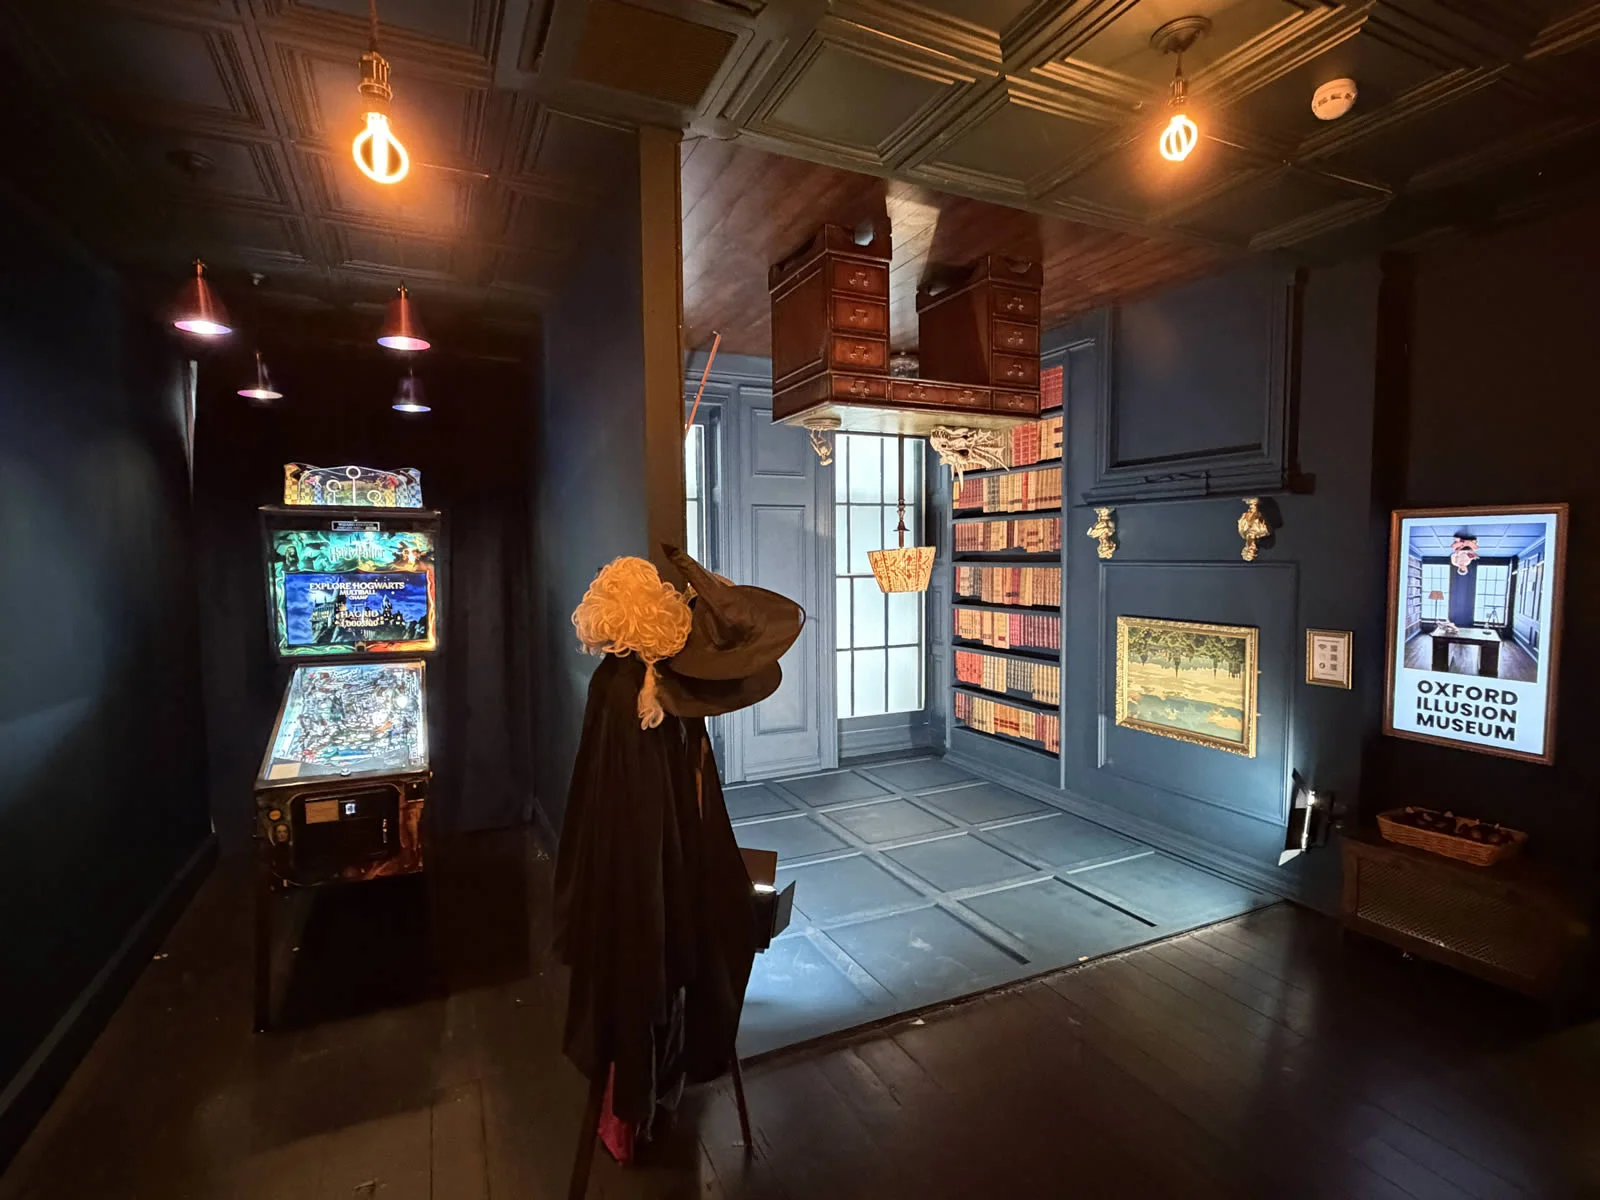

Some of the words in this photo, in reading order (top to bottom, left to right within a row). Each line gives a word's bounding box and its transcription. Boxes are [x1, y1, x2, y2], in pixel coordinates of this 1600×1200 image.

[353, 582, 405, 590] HOGWARTS
[340, 610, 379, 618] HAGRID
[1417, 680, 1518, 706] OXFORD
[1416, 696, 1517, 724] ILLUSION
[1416, 712, 1515, 741] MUSEUM
